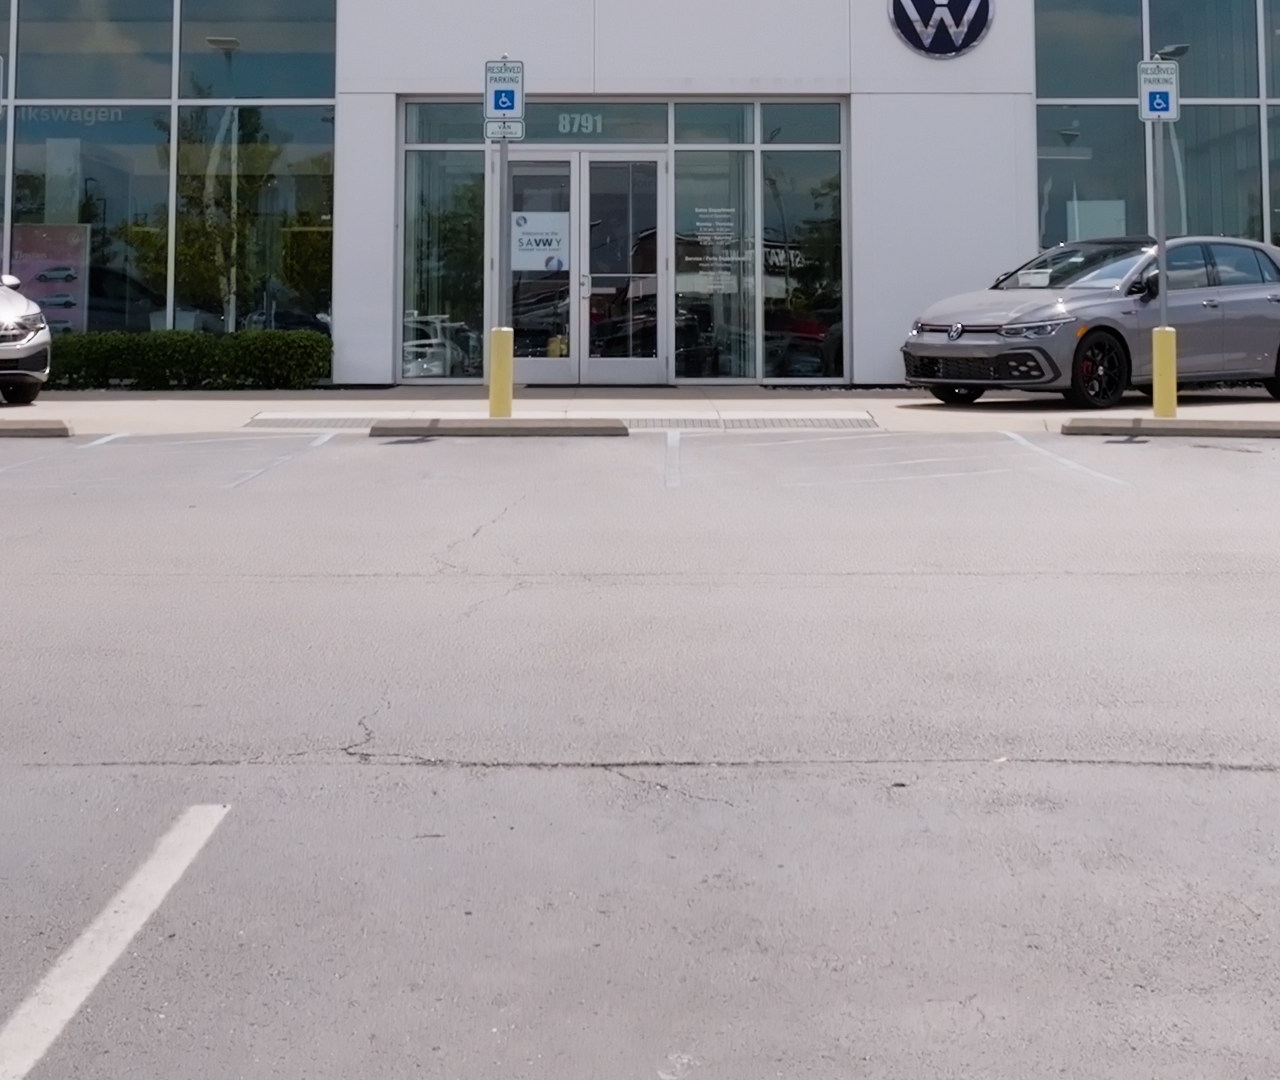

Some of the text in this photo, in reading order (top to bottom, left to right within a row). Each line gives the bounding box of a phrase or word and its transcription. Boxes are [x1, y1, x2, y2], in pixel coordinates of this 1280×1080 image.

[487, 66, 522, 74] RESERVED
[1141, 67, 1175, 75] RESERVED
[489, 76, 519, 84] PARKING
[1144, 77, 1173, 85] PARKING
[558, 113, 603, 134] 8791
